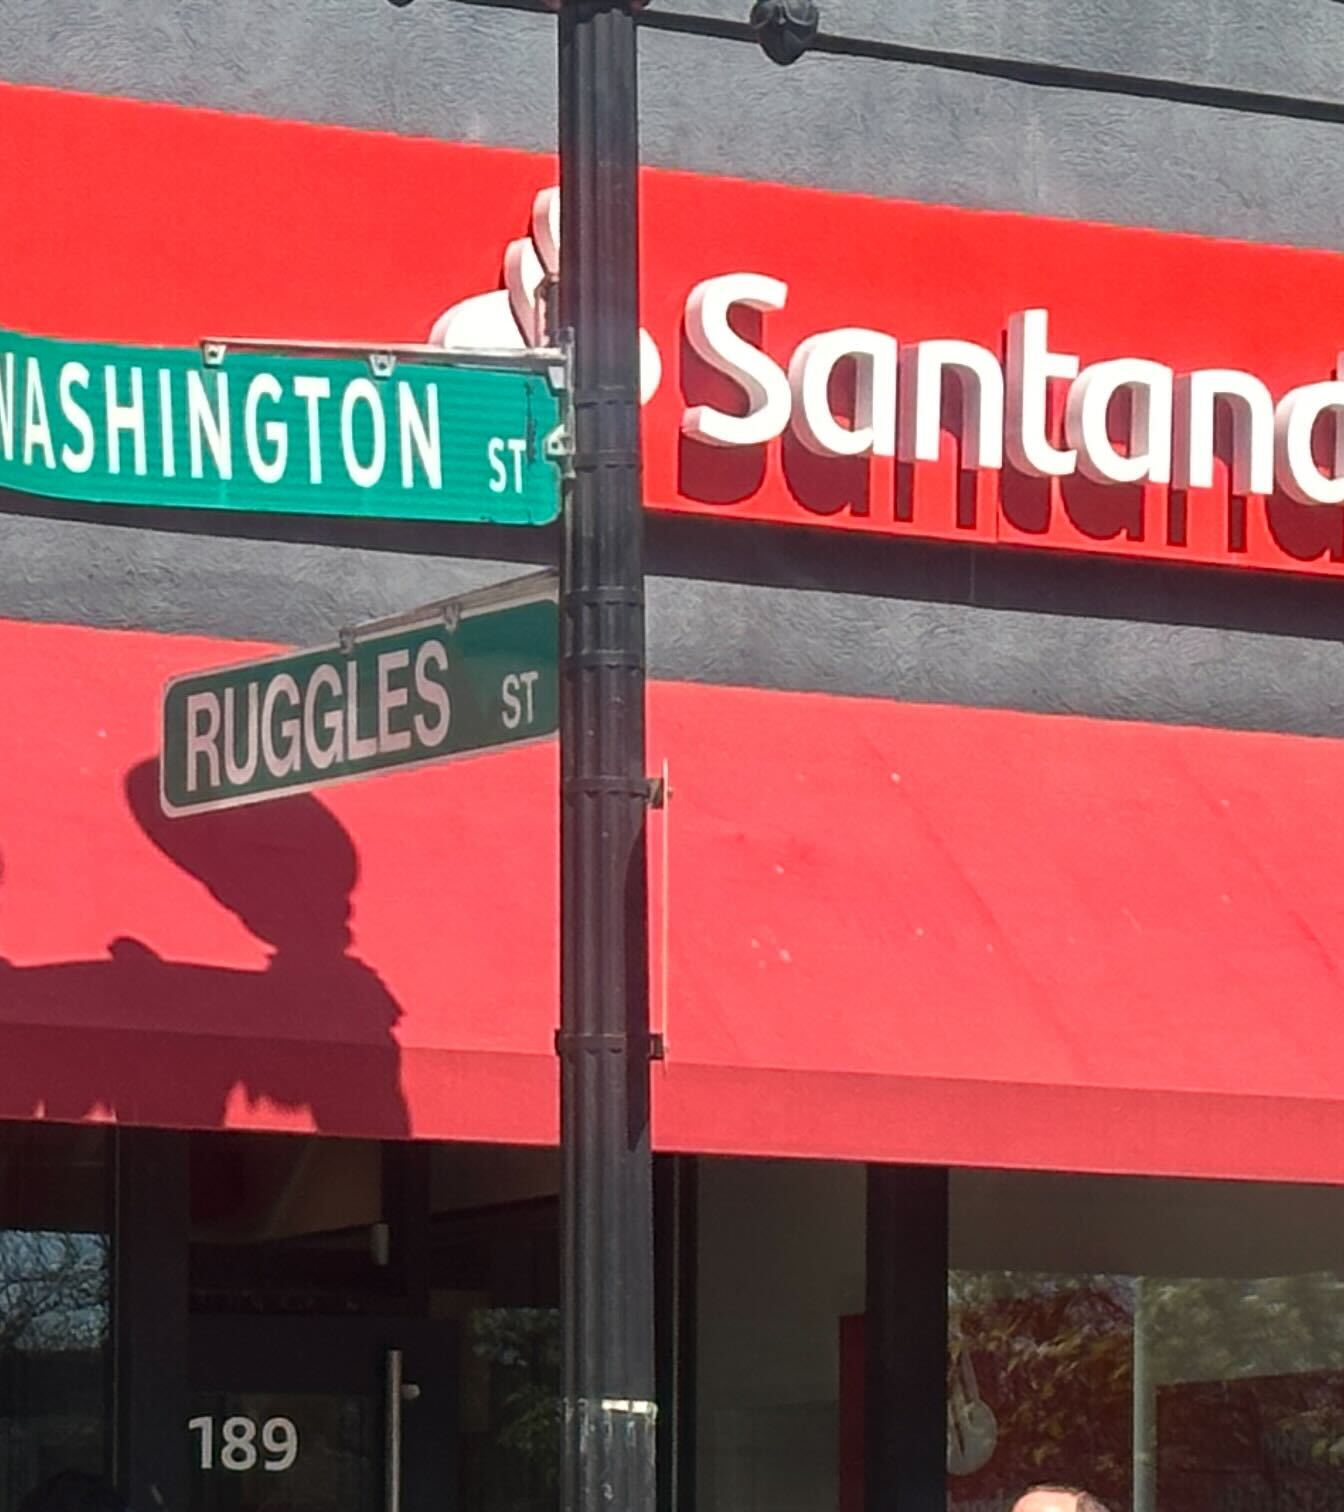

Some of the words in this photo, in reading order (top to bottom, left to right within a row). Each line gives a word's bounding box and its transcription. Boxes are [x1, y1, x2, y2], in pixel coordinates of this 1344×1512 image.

[489, 436, 526, 494] ST
[186, 640, 452, 793] RUGGLES
[501, 671, 539, 731] ST
[187, 1415, 299, 1472] 189
